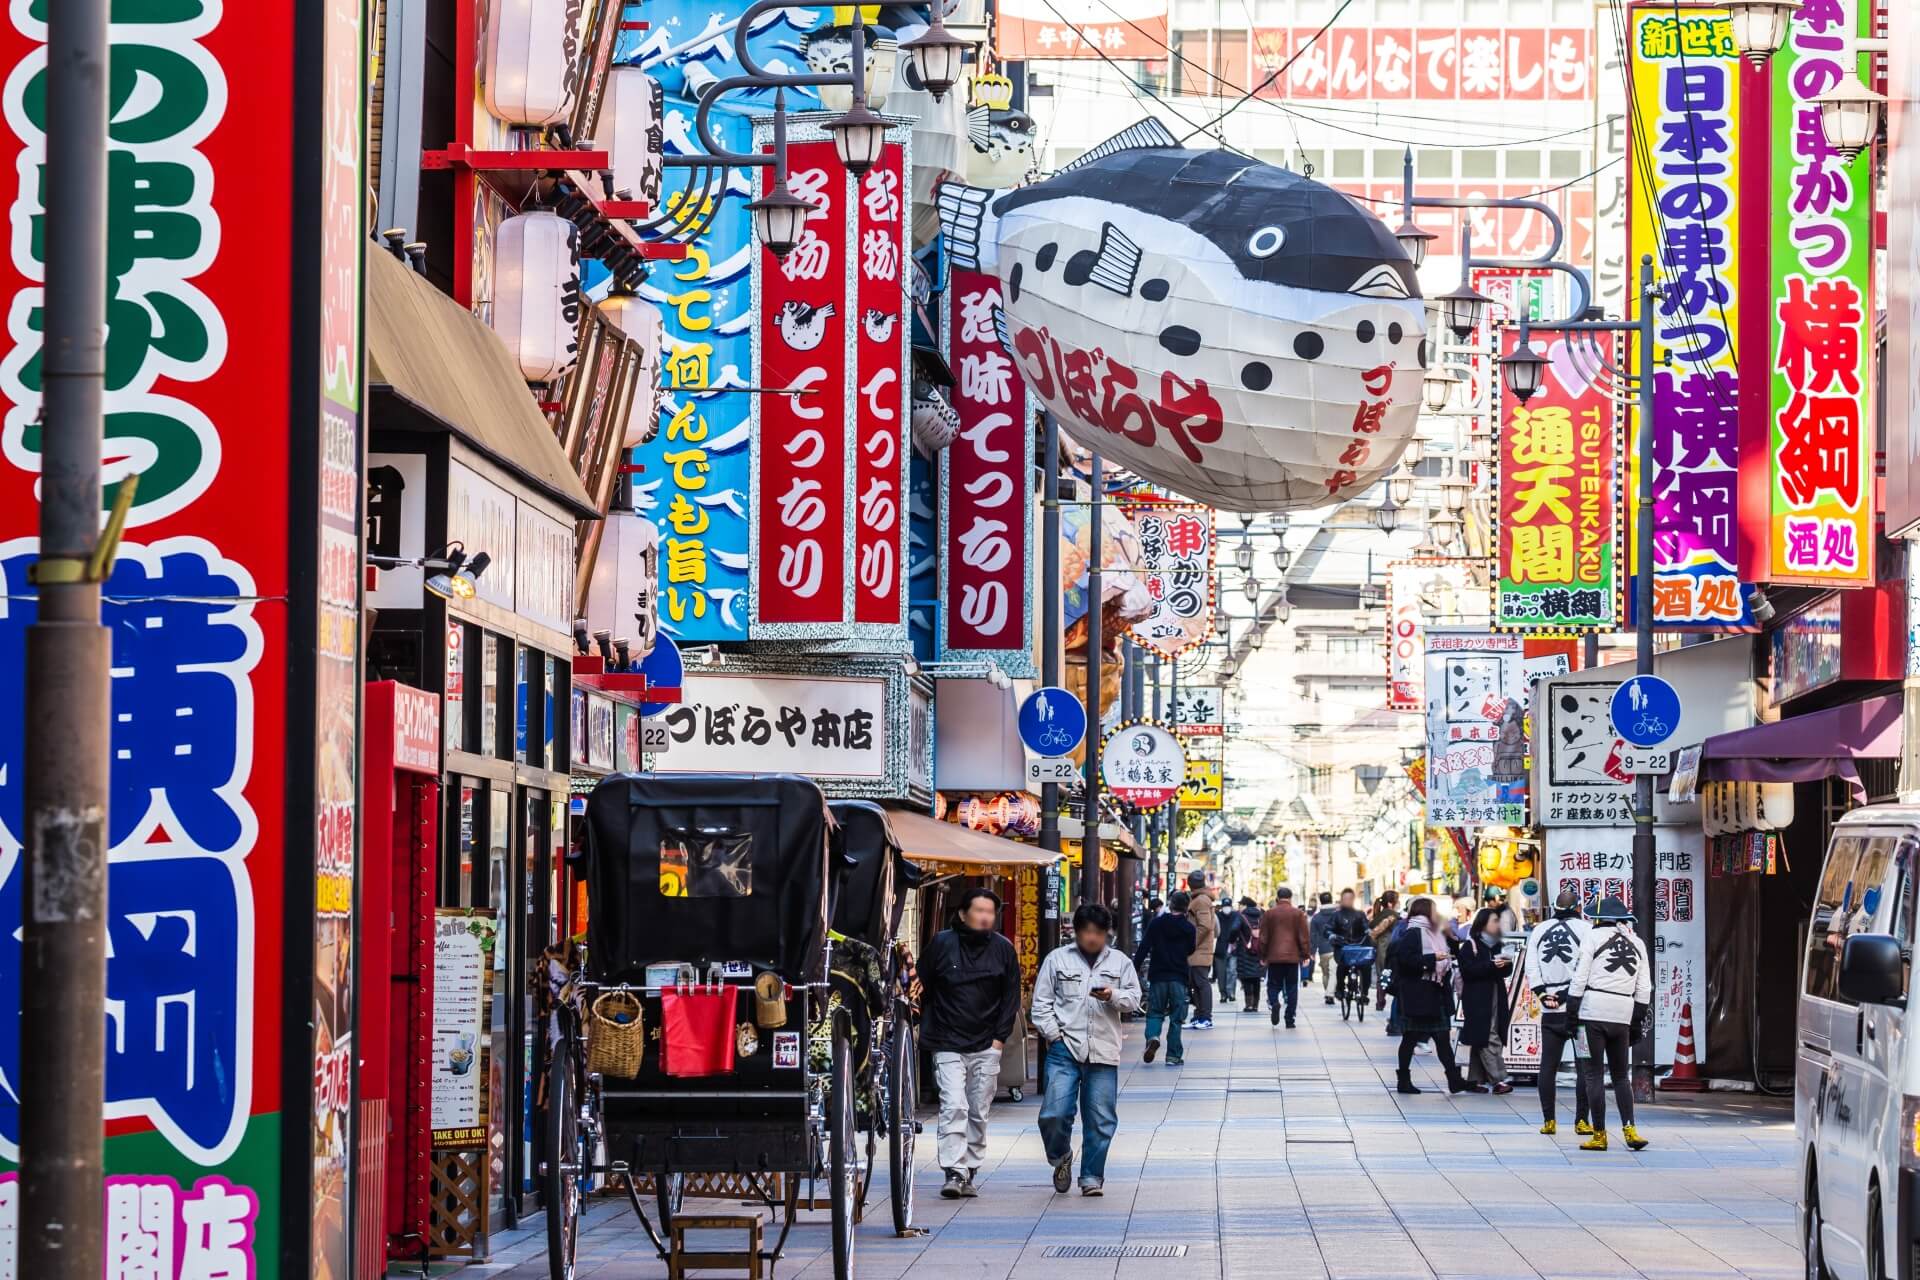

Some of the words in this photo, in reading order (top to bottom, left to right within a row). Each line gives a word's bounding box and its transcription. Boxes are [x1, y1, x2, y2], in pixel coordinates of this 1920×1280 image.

[1037, 26, 1127, 49] 年中無休
[1292, 35, 1593, 92] みんなで楽しも
[1659, 66, 1729, 361] 日本一の串かつ
[1014, 326, 1224, 464] づぼらや
[1779, 278, 1862, 508] 横綱
[1324, 360, 1398, 495] づぼらや
[777, 366, 828, 598] てっちり
[860, 367, 897, 599] てっちり
[958, 288, 1014, 637] 珍味てっちり
[1510, 406, 1575, 584] 通天閣
[1578, 404, 1600, 582] TSUTENKAKU
[1167, 517, 1205, 615] 串かつ
[1788, 520, 1854, 567] 酒処
[1503, 594, 1539, 603] 日本一の
[1503, 606, 1539, 617] 串かつ
[1540, 589, 1602, 619] 横綱
[1652, 578, 1739, 618] 酒処
[1431, 638, 1518, 649] 元祖串カツ専門店
[644, 729, 665, 746] 22
[665, 703, 873, 750] づぼらや本店
[1431, 807, 1521, 821] 宴会予約受付中
[1550, 808, 1564, 820] 2F
[1566, 807, 1636, 820] 座敷ありま
[1551, 793, 1564, 803] 1F
[1567, 792, 1637, 804] カウンター
[1560, 852, 1693, 871] 元祖串カ門店
[432, 1131, 453, 1140] TAKE
[454, 1130, 469, 1139] OUT
[471, 1128, 485, 1138] OK!
